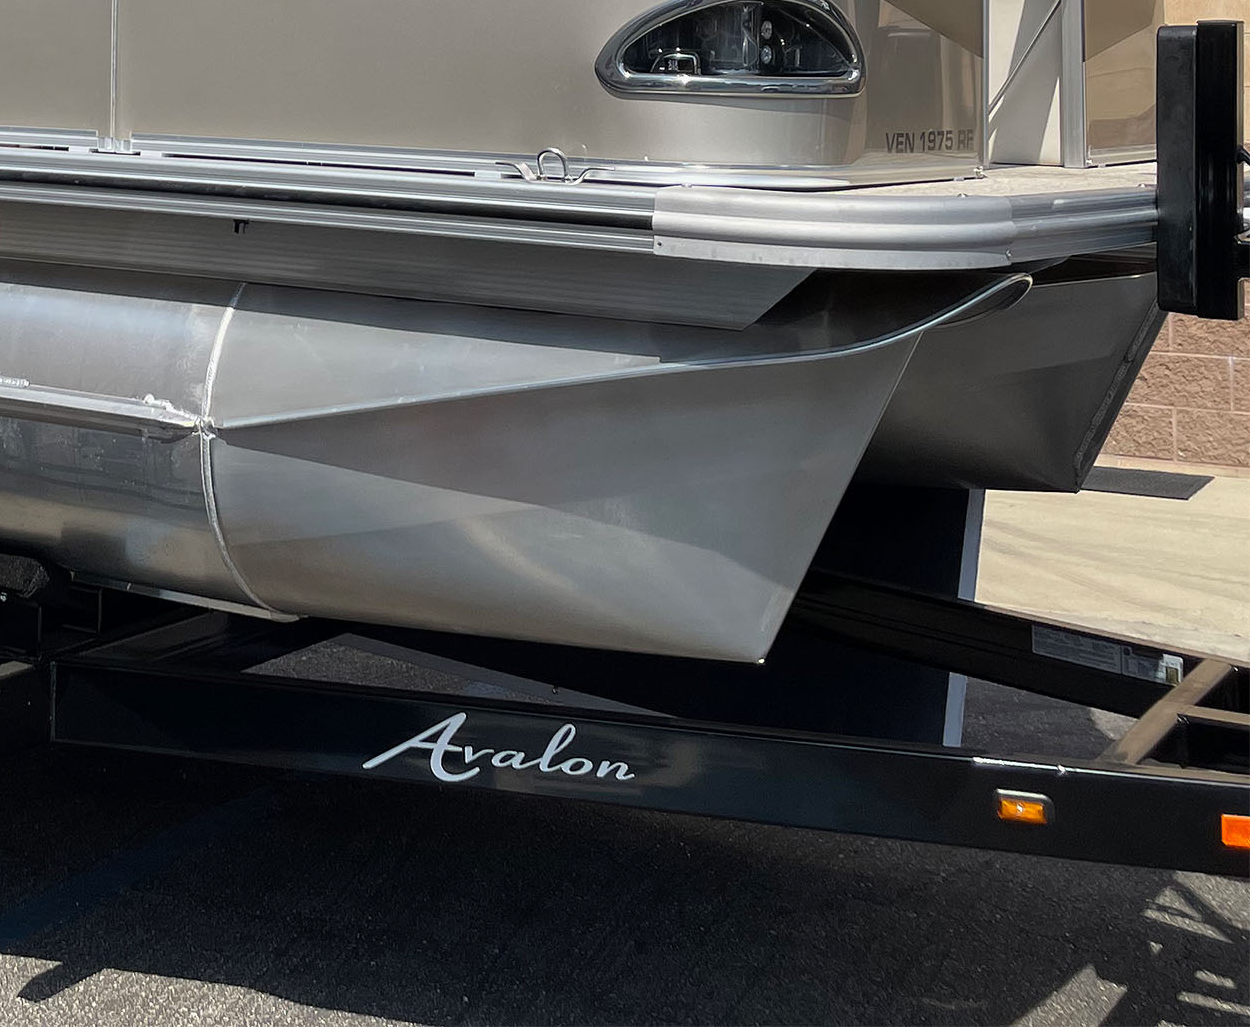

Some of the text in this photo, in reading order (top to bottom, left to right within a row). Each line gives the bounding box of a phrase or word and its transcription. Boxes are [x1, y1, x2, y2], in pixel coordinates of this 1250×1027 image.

[885, 132, 915, 153] VEN
[919, 129, 954, 152] 1975
[362, 711, 635, 782] Avalon
